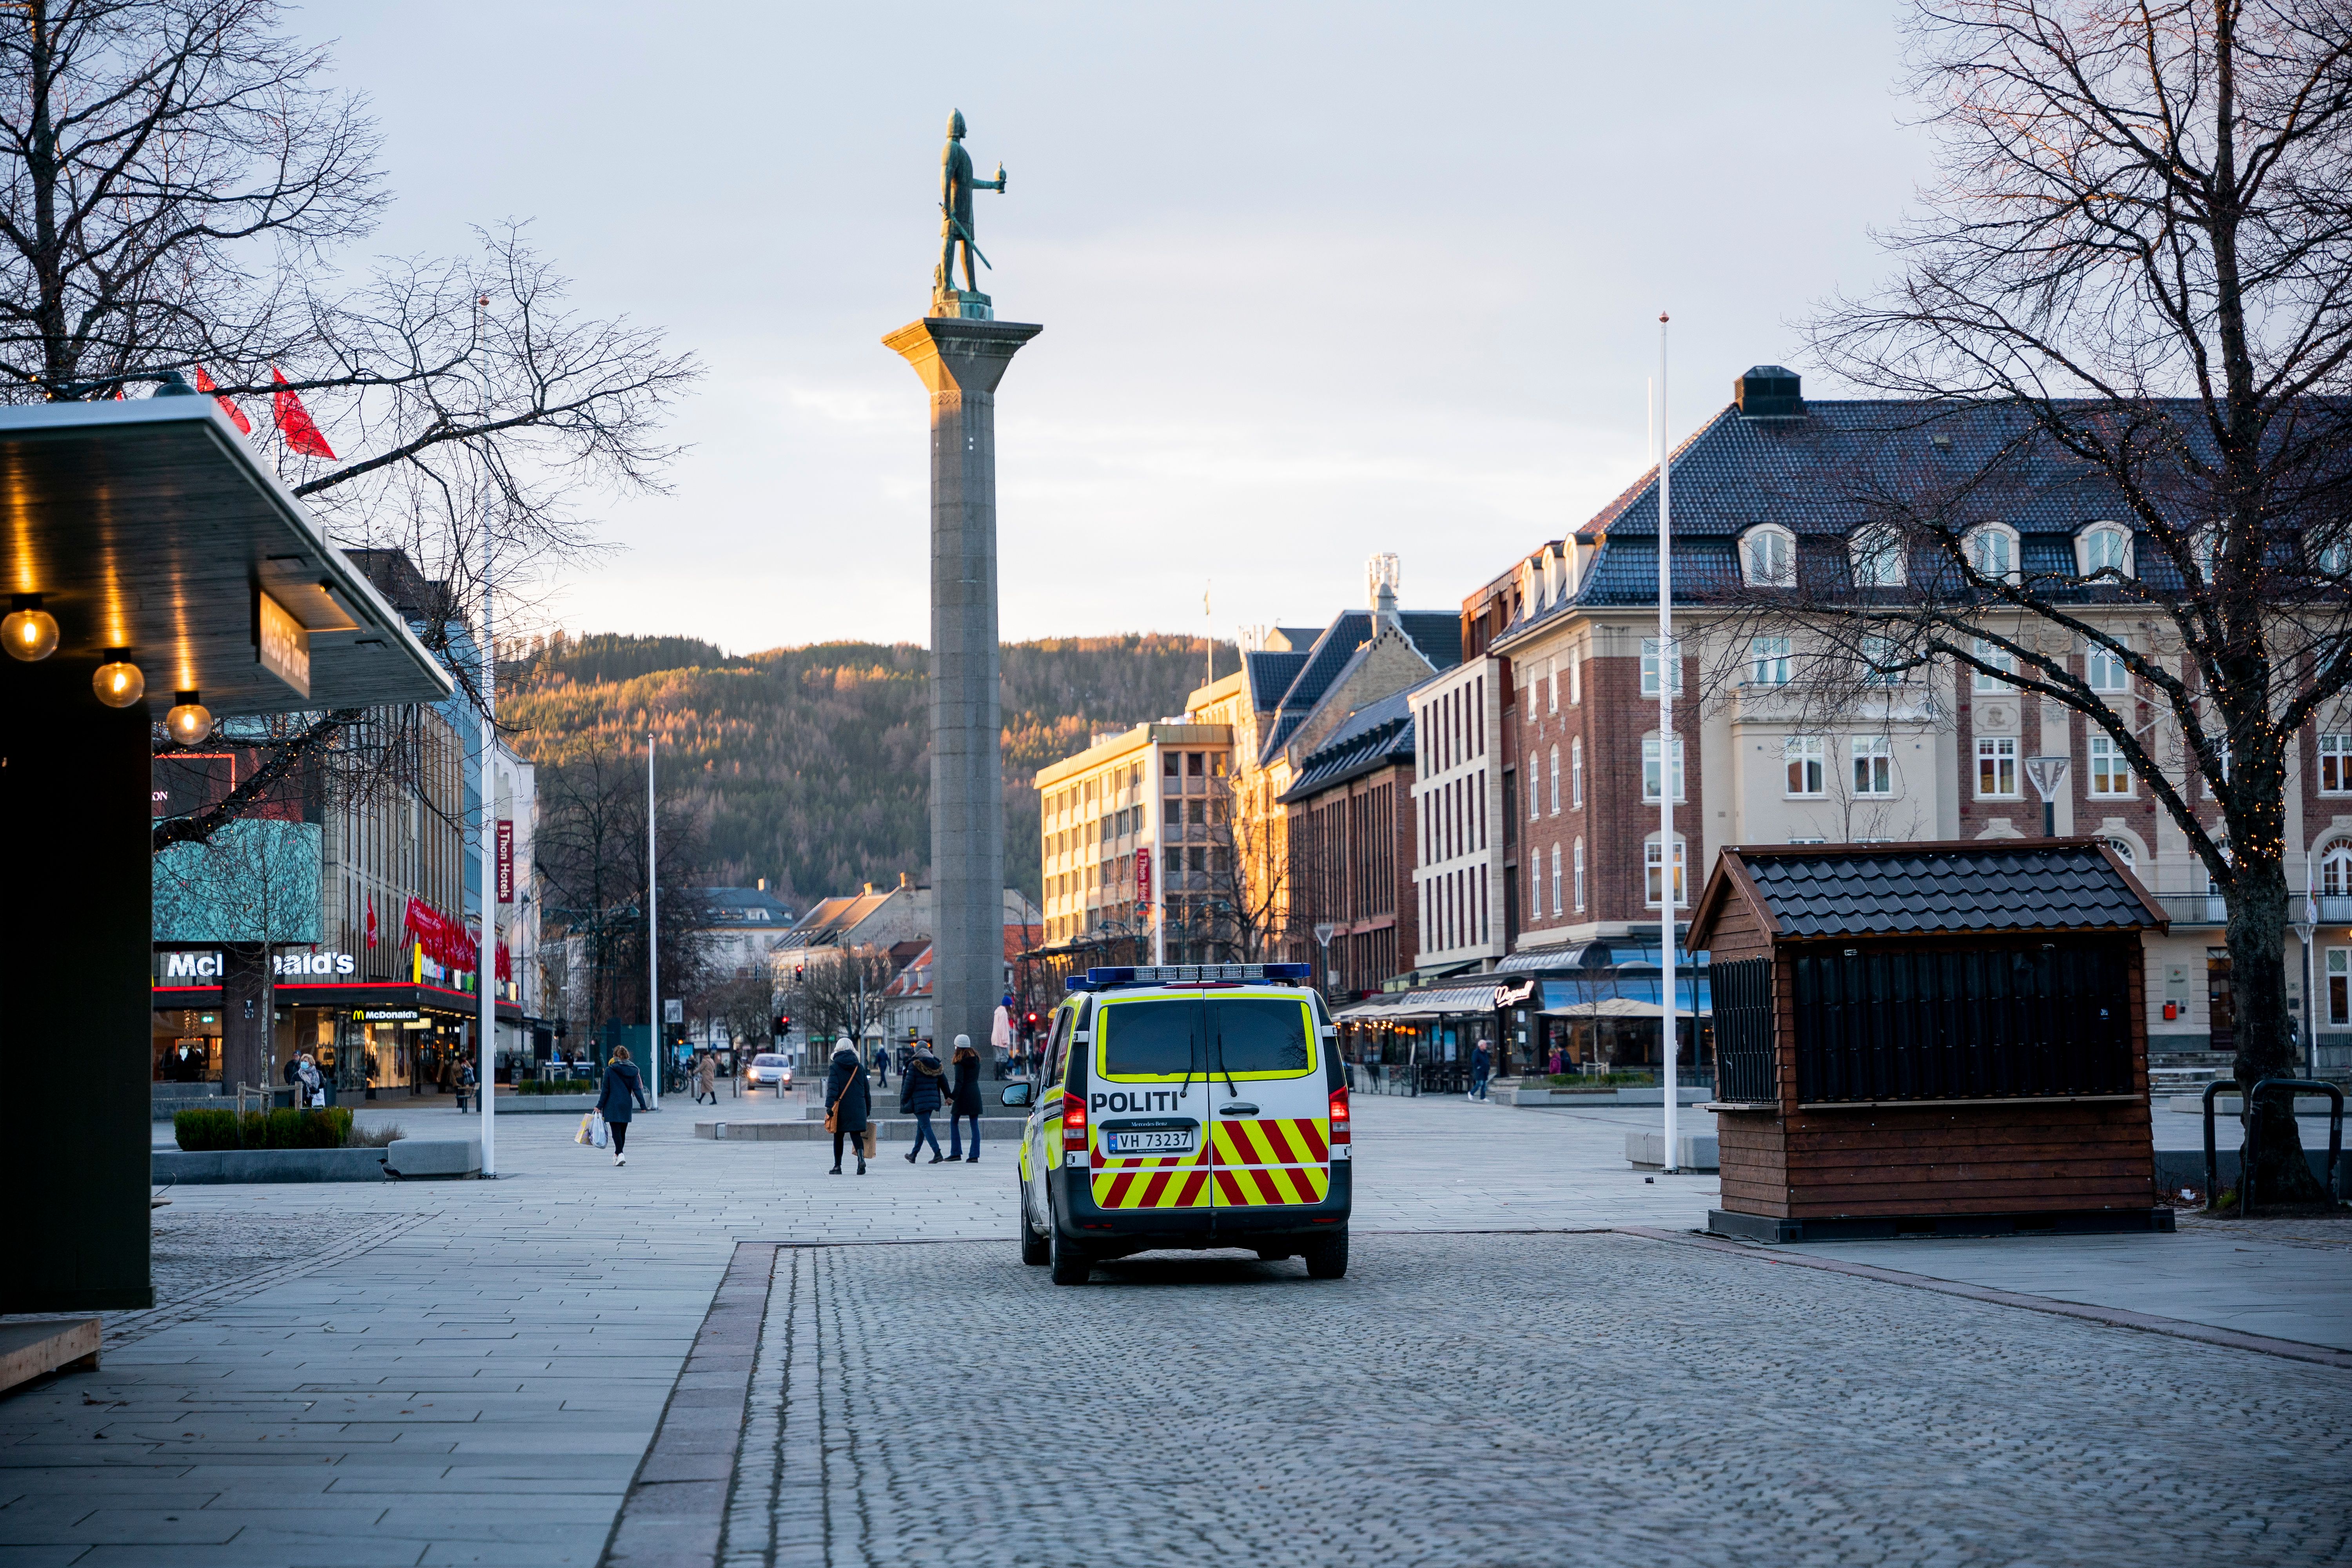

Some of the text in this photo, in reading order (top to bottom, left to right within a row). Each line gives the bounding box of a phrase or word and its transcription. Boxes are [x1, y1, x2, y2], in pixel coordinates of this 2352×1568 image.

[500, 832, 510, 898] Thon Hotels
[1139, 857, 1148, 902] Thon Hot
[167, 952, 354, 977] Mcald's
[366, 1011, 418, 1019] McDonald's
[1091, 1091, 1178, 1113] POLITI
[1120, 1133, 1189, 1148] VH 73237
